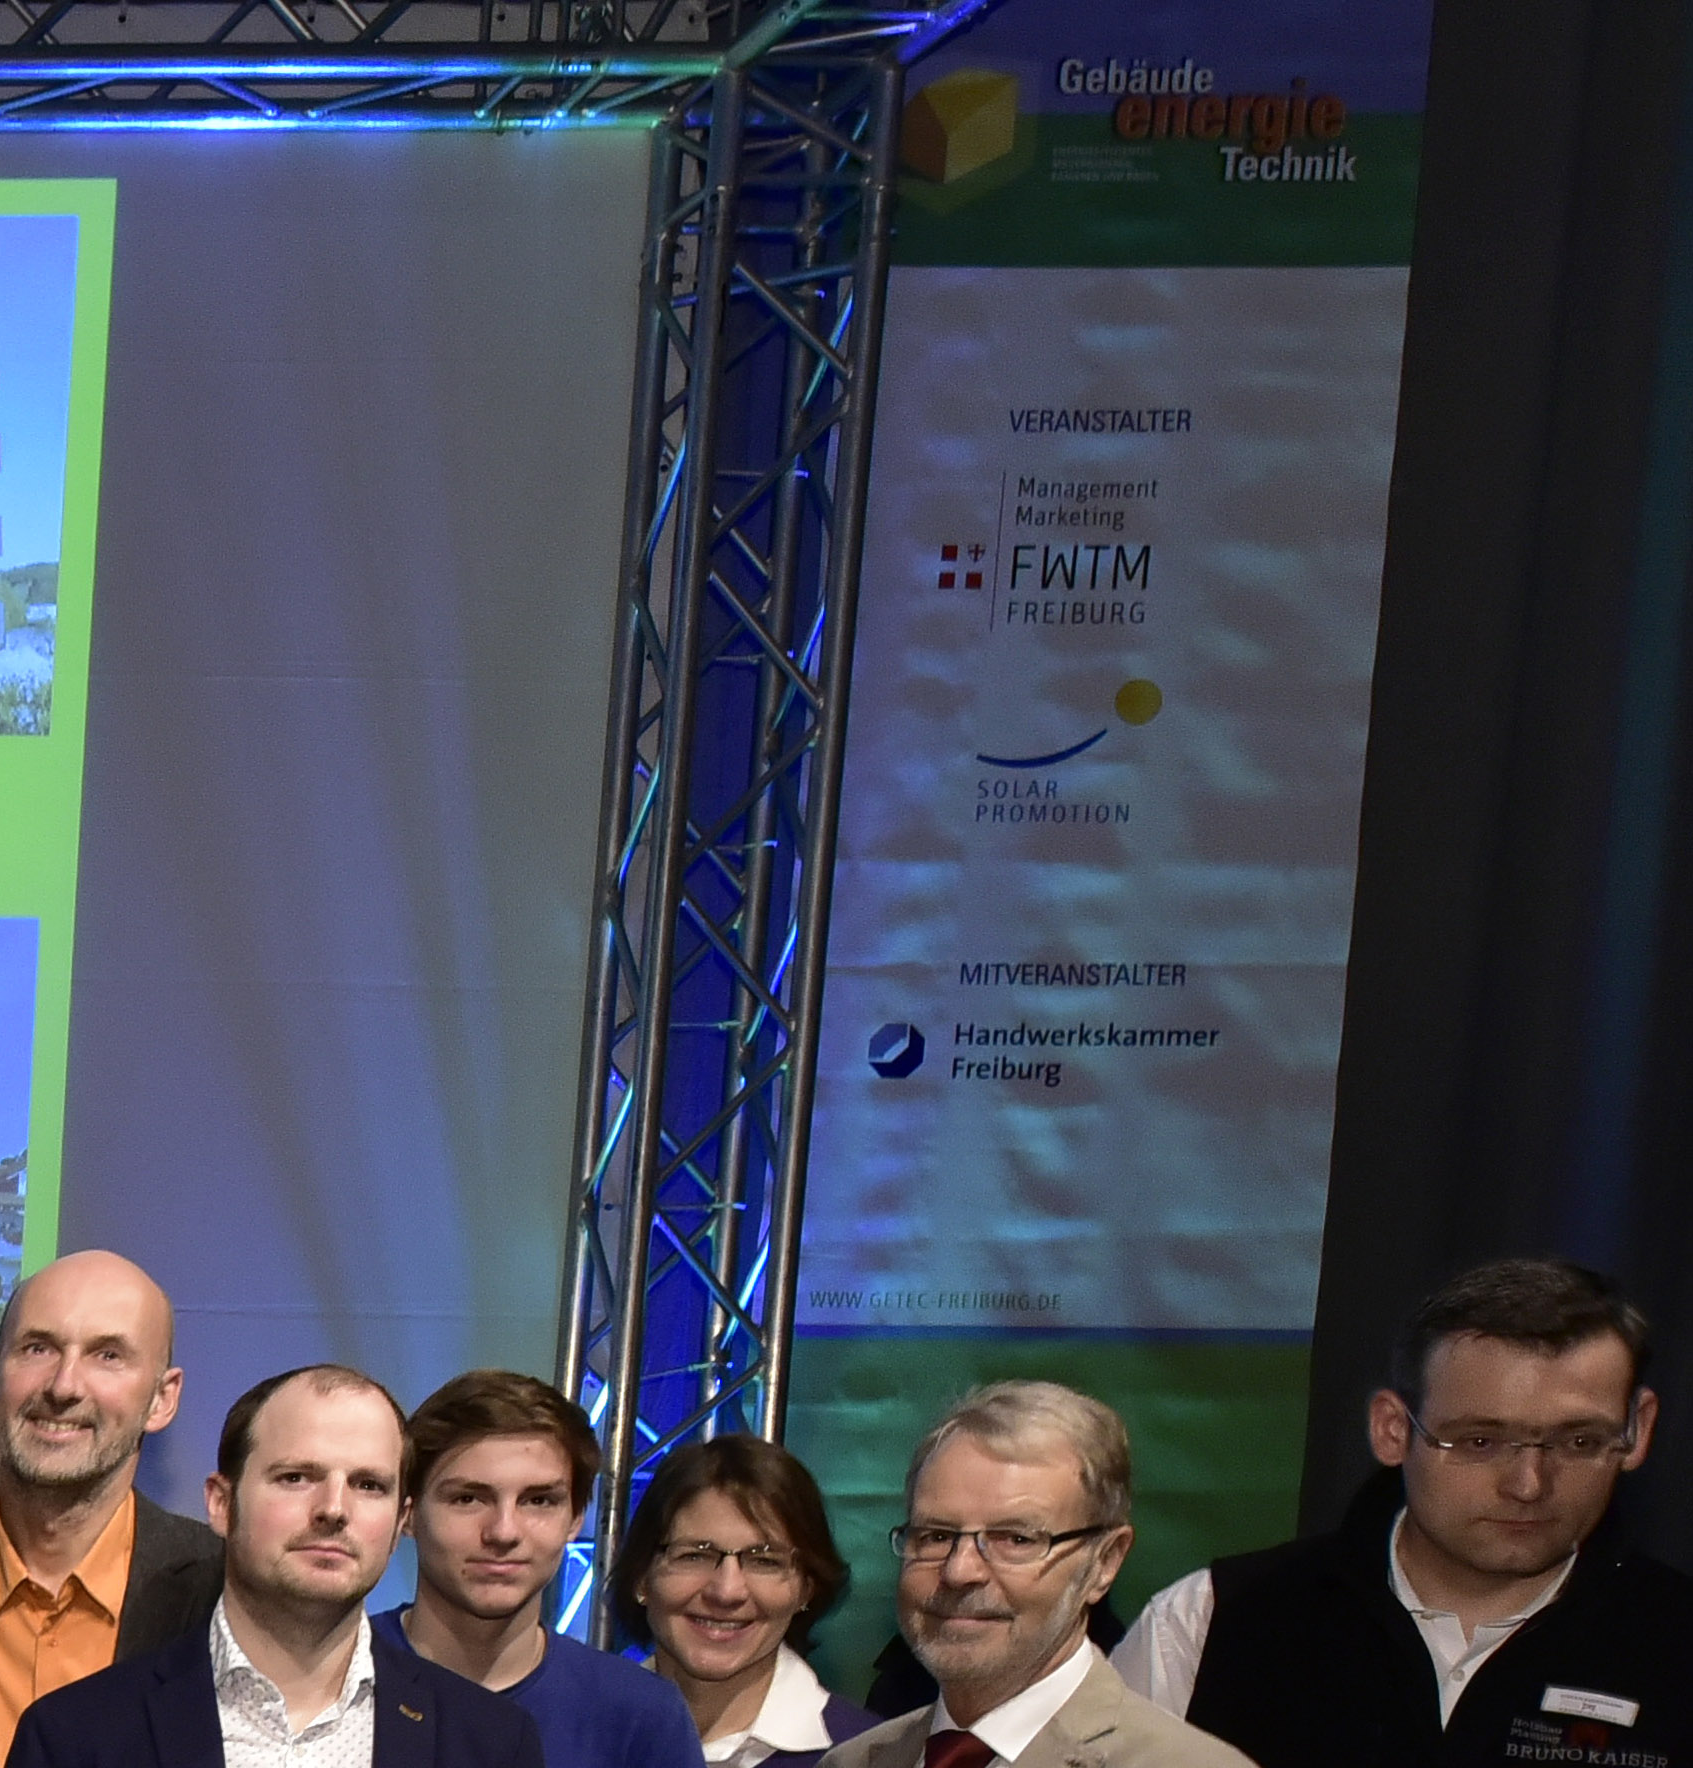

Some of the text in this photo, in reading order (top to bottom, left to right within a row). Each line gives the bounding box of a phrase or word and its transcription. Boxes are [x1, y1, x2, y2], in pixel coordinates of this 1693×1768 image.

[1059, 59, 1214, 95] Gebäude
[1116, 77, 1347, 154] energie
[1219, 146, 1357, 183] Technik
[1009, 410, 1192, 433] VERANSTALTER
[1016, 477, 1158, 503] Management
[1014, 505, 1125, 531] Marketing
[1010, 544, 1151, 591] FWTM
[1006, 600, 1146, 625] FREIBURG
[977, 779, 1058, 800] SOLAR
[975, 803, 1131, 824] PROMOTION
[960, 963, 1187, 987] MITVERANSTALTER
[954, 1022, 1220, 1048] Handwerkskammer
[951, 1057, 1061, 1086] Freiburg
[1505, 1742, 1583, 1762] BRUNO
